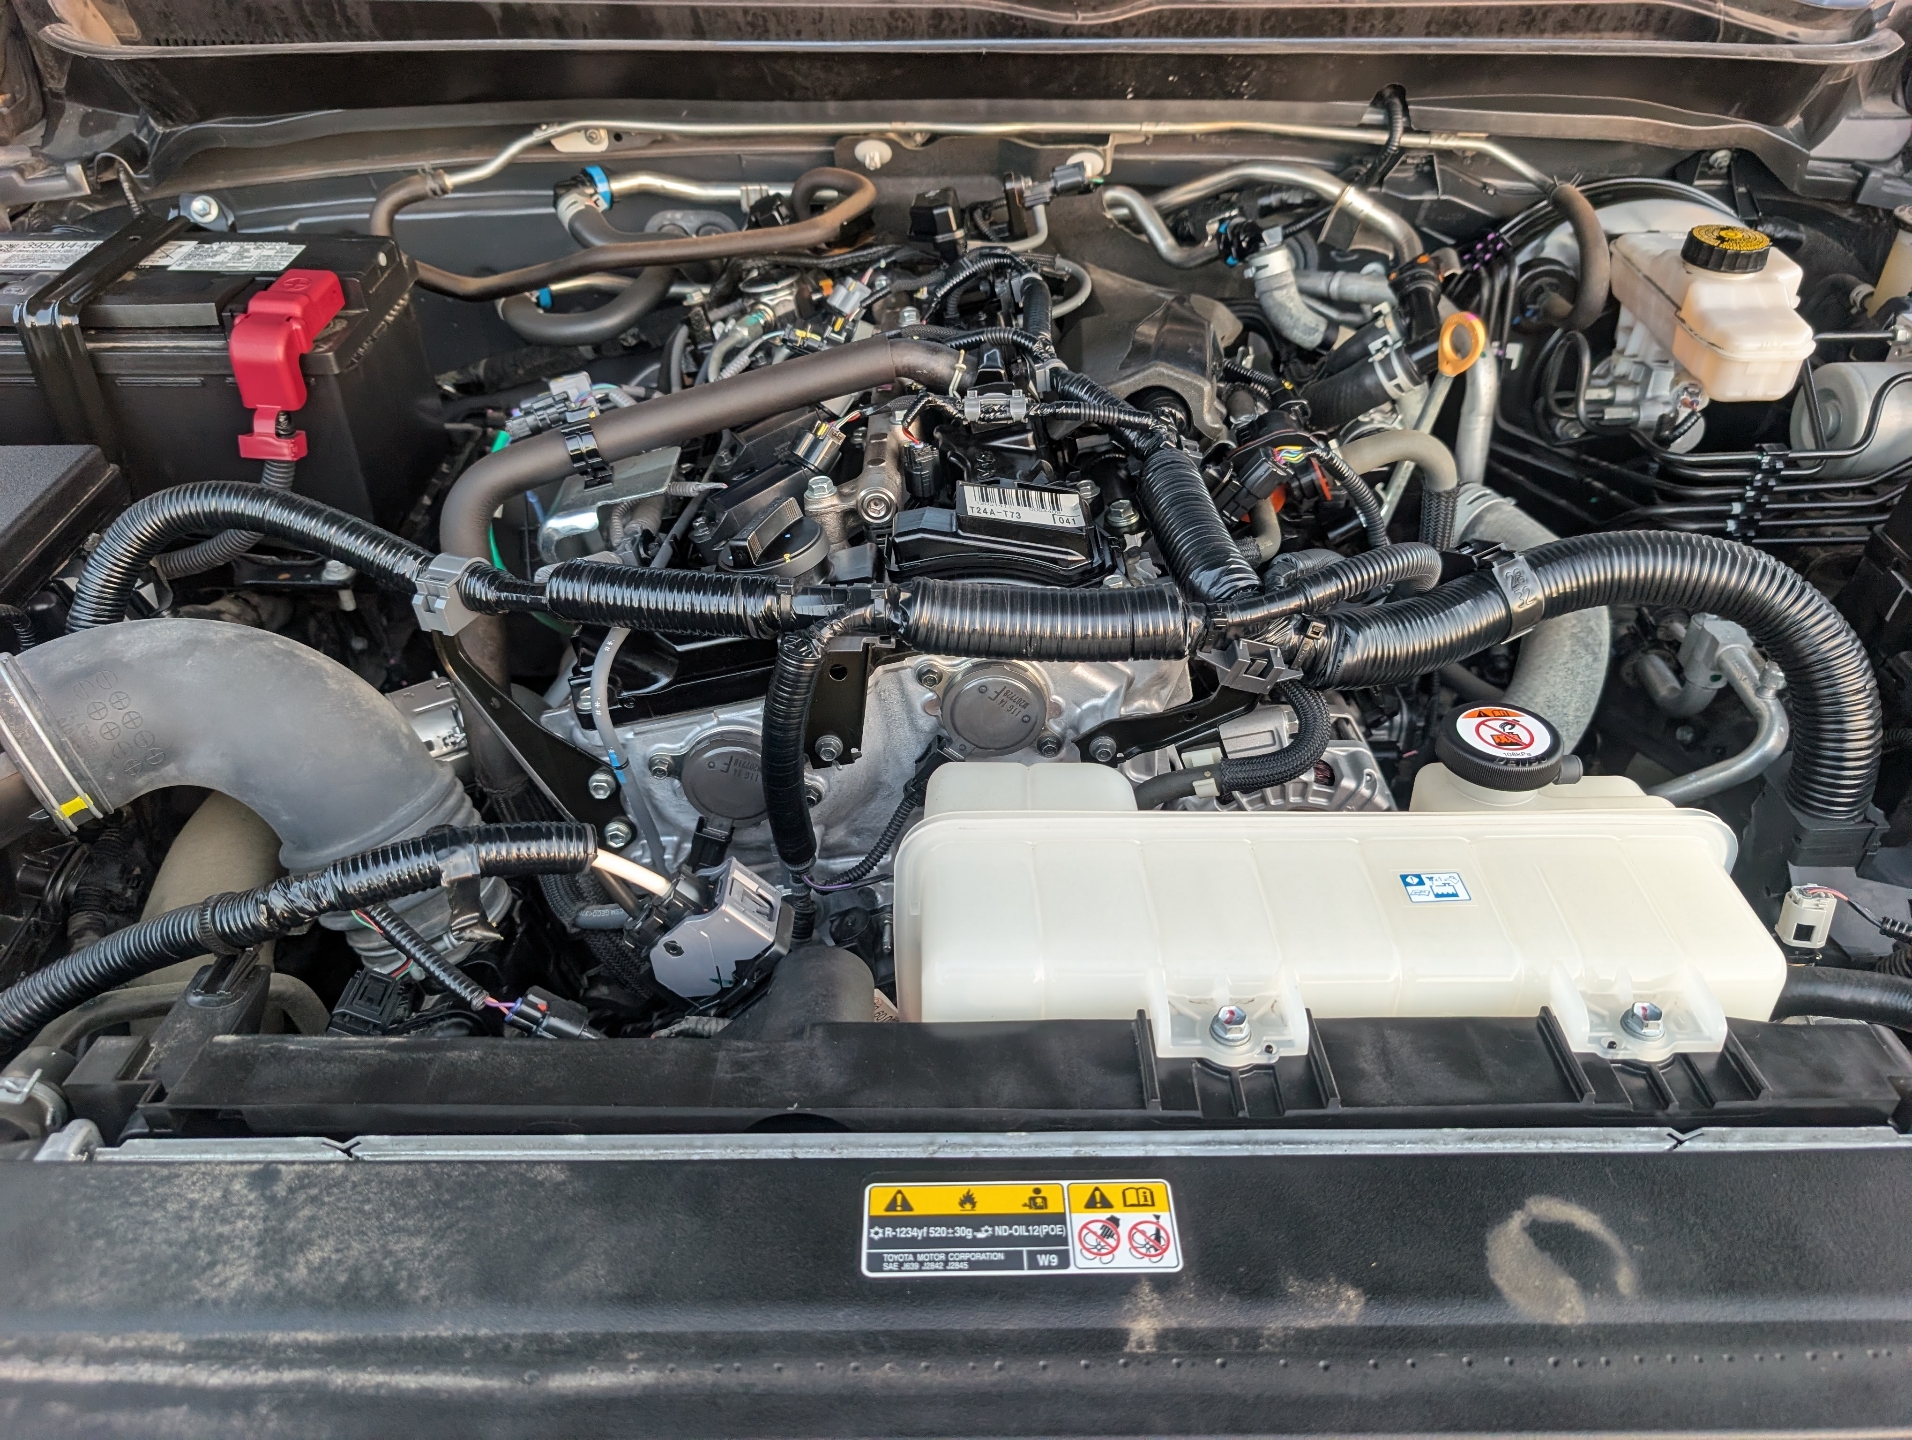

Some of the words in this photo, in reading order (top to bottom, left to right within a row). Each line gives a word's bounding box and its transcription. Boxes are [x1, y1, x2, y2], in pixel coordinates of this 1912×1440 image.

[970, 505, 1022, 519] T24A-T73
[1058, 516, 1077, 525] 041
[884, 1226, 928, 1240] R-1234yf
[929, 1226, 973, 1240] 520±30g
[994, 1225, 1067, 1238] ND-OIL12(POE)
[882, 1253, 913, 1262] TOYOTA
[917, 1253, 946, 1261] MOTOR
[948, 1252, 1005, 1261] CORPORATION
[1036, 1254, 1059, 1267] W9
[882, 1262, 899, 1270] SAE
[901, 1262, 919, 1270] J639
[921, 1261, 944, 1270] J2842
[946, 1261, 969, 1270] J2845
